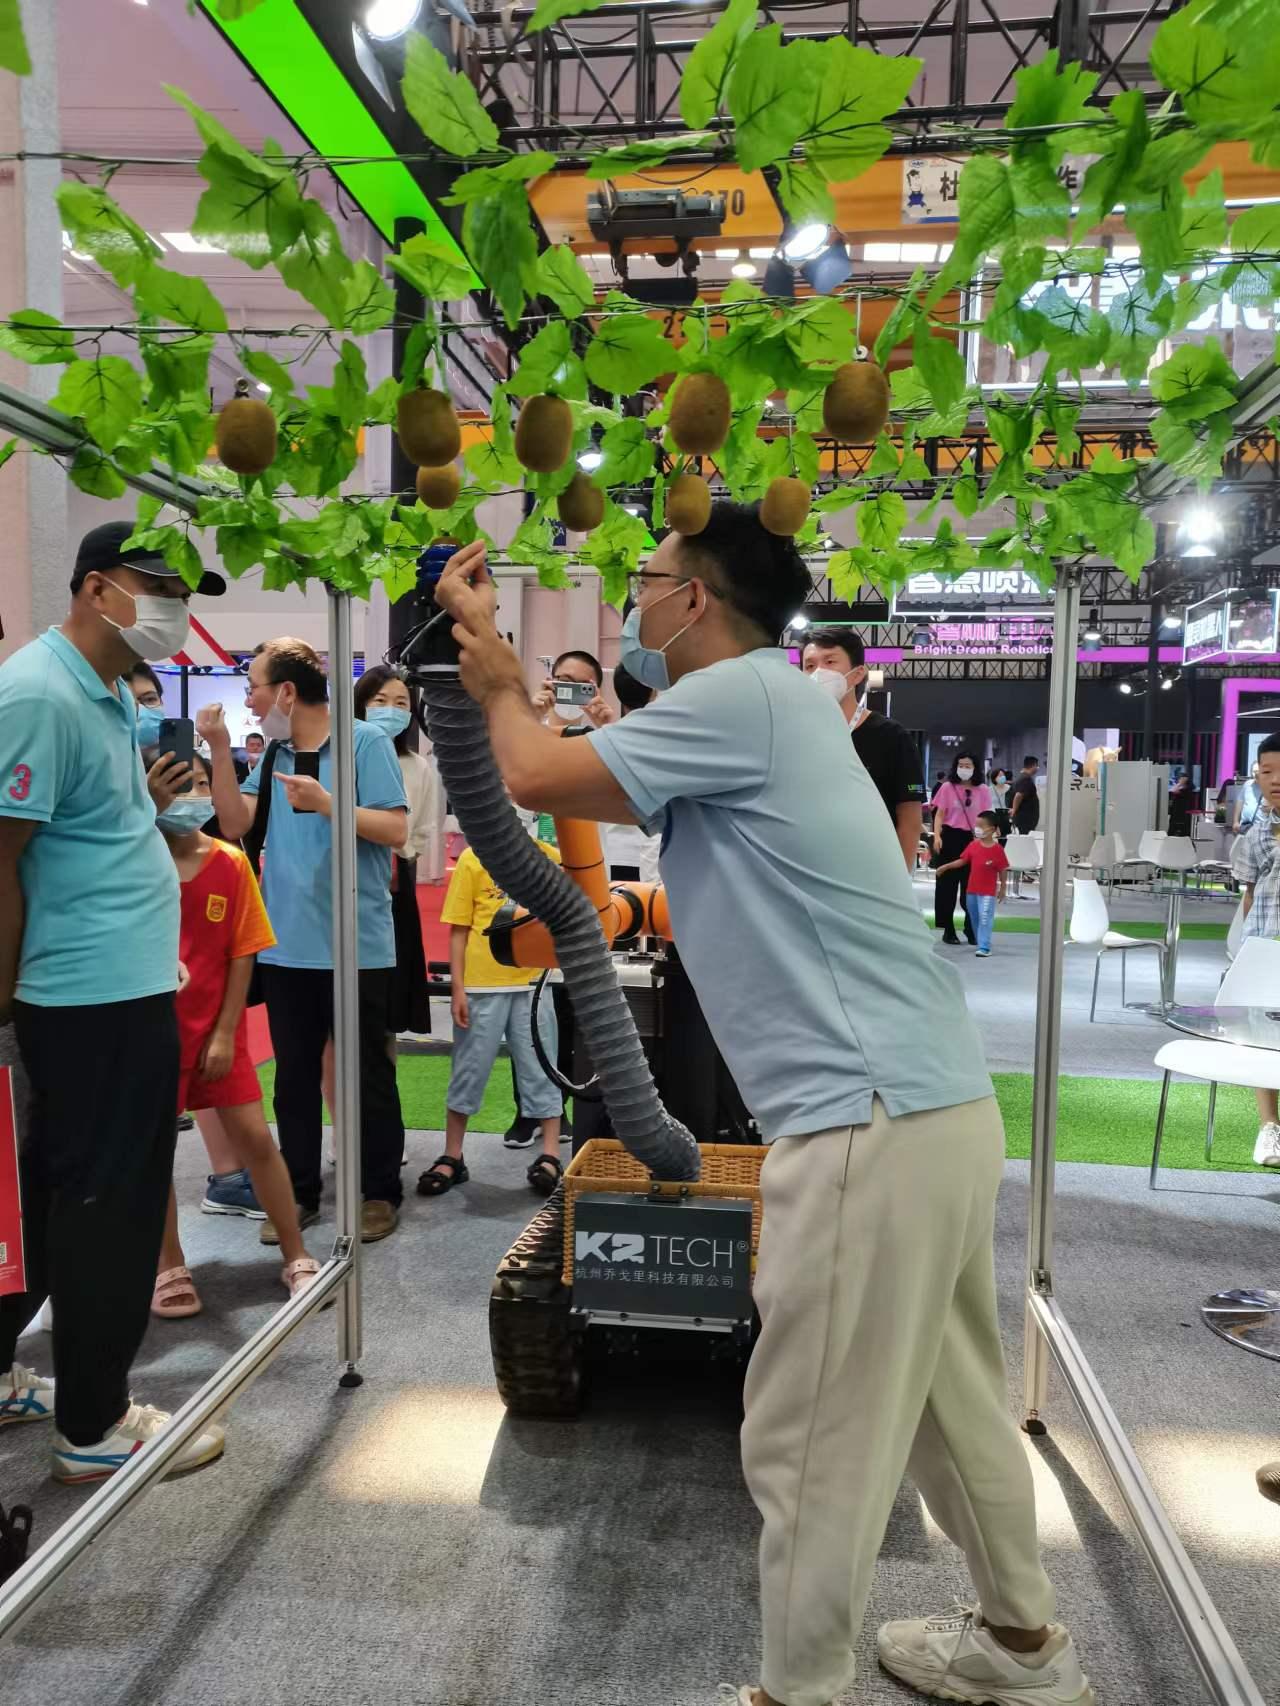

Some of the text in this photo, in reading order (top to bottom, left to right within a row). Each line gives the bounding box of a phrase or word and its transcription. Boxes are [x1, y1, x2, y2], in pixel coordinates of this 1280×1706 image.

[914, 644, 953, 655] Bright
[956, 644, 996, 654] Dream
[9, 763, 32, 801] 3
[575, 1230, 645, 1265] K2
[575, 1267, 735, 1289] 杭州乔戈里科技有限公司
